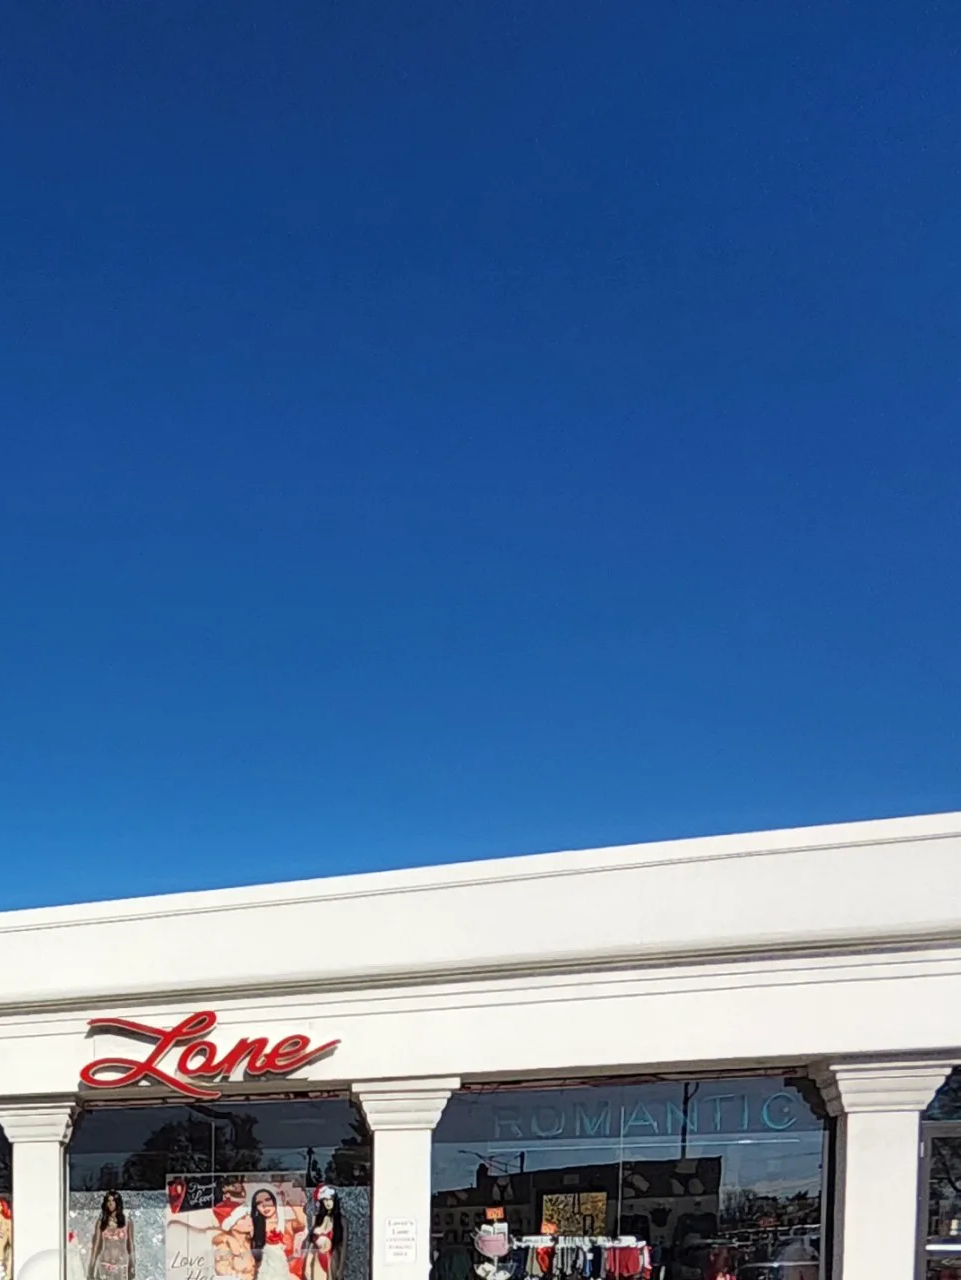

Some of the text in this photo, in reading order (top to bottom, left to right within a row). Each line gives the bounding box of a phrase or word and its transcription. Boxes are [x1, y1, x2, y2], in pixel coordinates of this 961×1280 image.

[80, 1010, 341, 1098] Lane
[494, 1091, 799, 1138] ROMANTIC
[171, 1251, 204, 1269] Love
